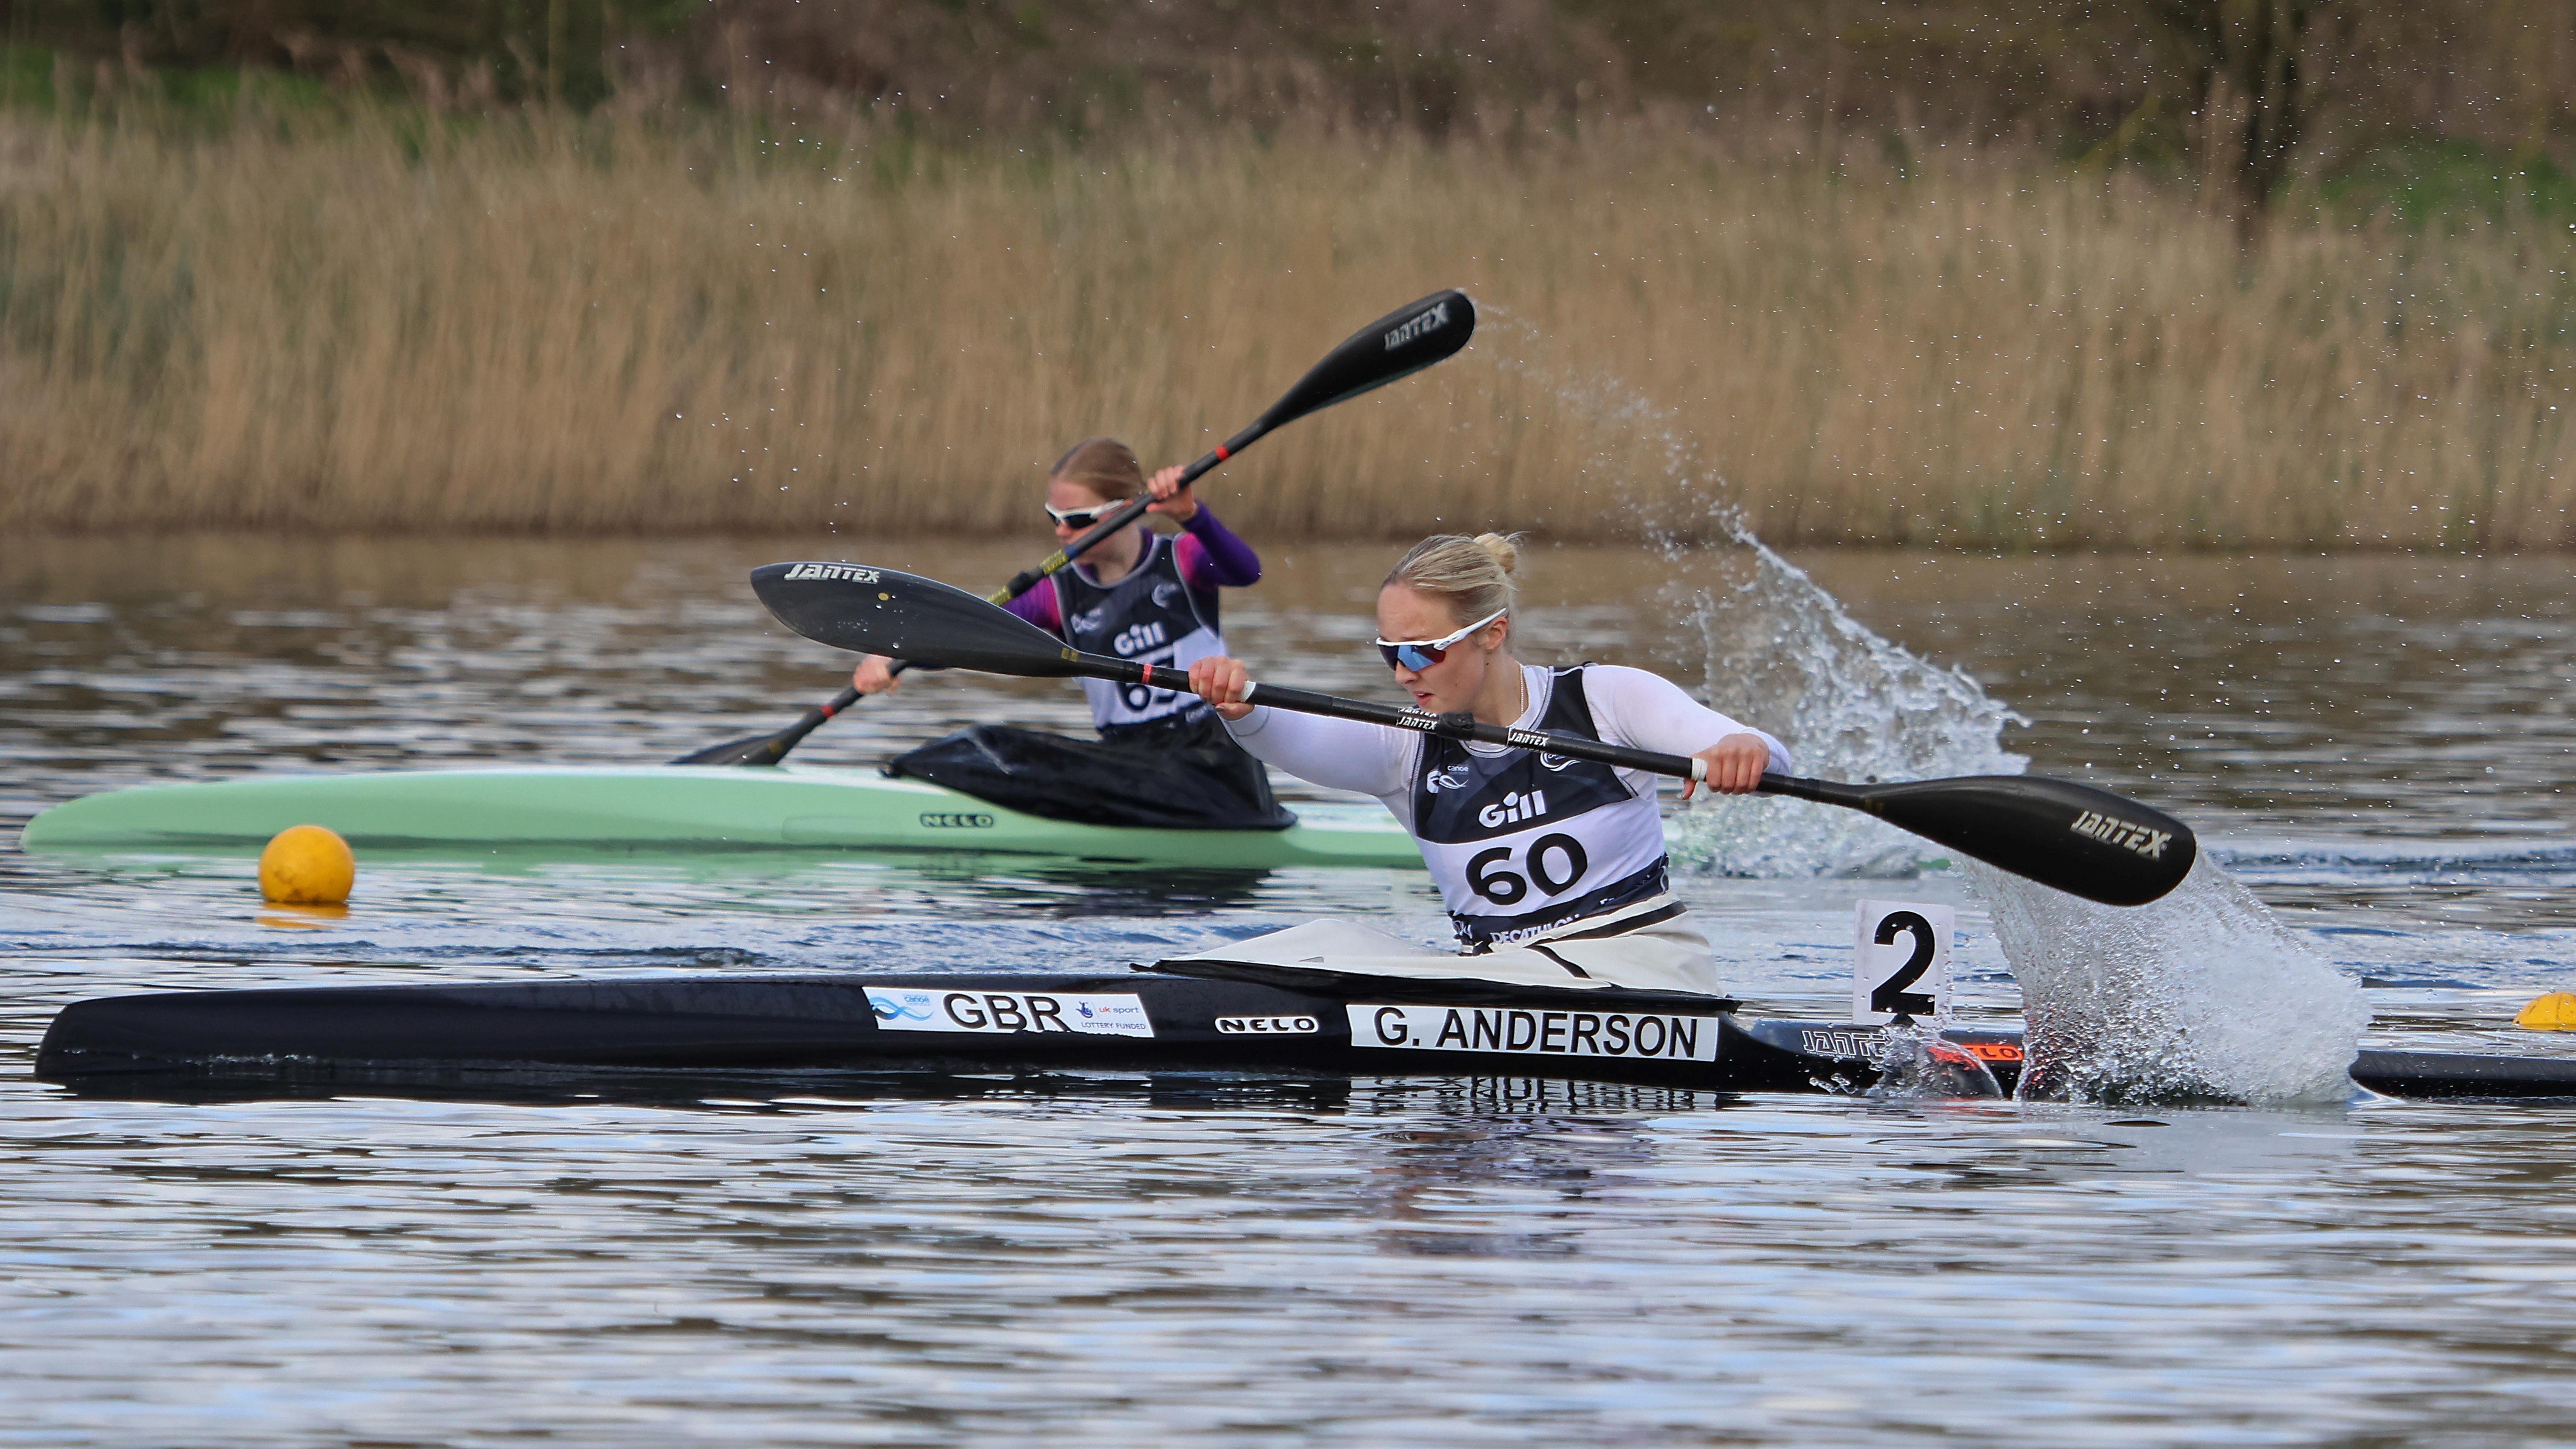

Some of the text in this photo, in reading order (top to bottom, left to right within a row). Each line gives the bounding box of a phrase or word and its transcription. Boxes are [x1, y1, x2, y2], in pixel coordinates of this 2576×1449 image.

[784, 564, 880, 584] JANTEX
[1114, 621, 1165, 655] Gill
[1398, 716, 1438, 730] JANTEX
[1509, 732, 1549, 747] JANTEX
[1478, 789, 1547, 828] Gill
[2070, 810, 2172, 861] JANTEX
[1465, 833, 1588, 906] 60
[1870, 911, 1936, 1015] 2
[943, 993, 1070, 1031] GBR
[1219, 1018, 1315, 1031] NELO
[1373, 1007, 1697, 1058] G. ANDERSON
[1802, 1030, 1892, 1058] JANTE
